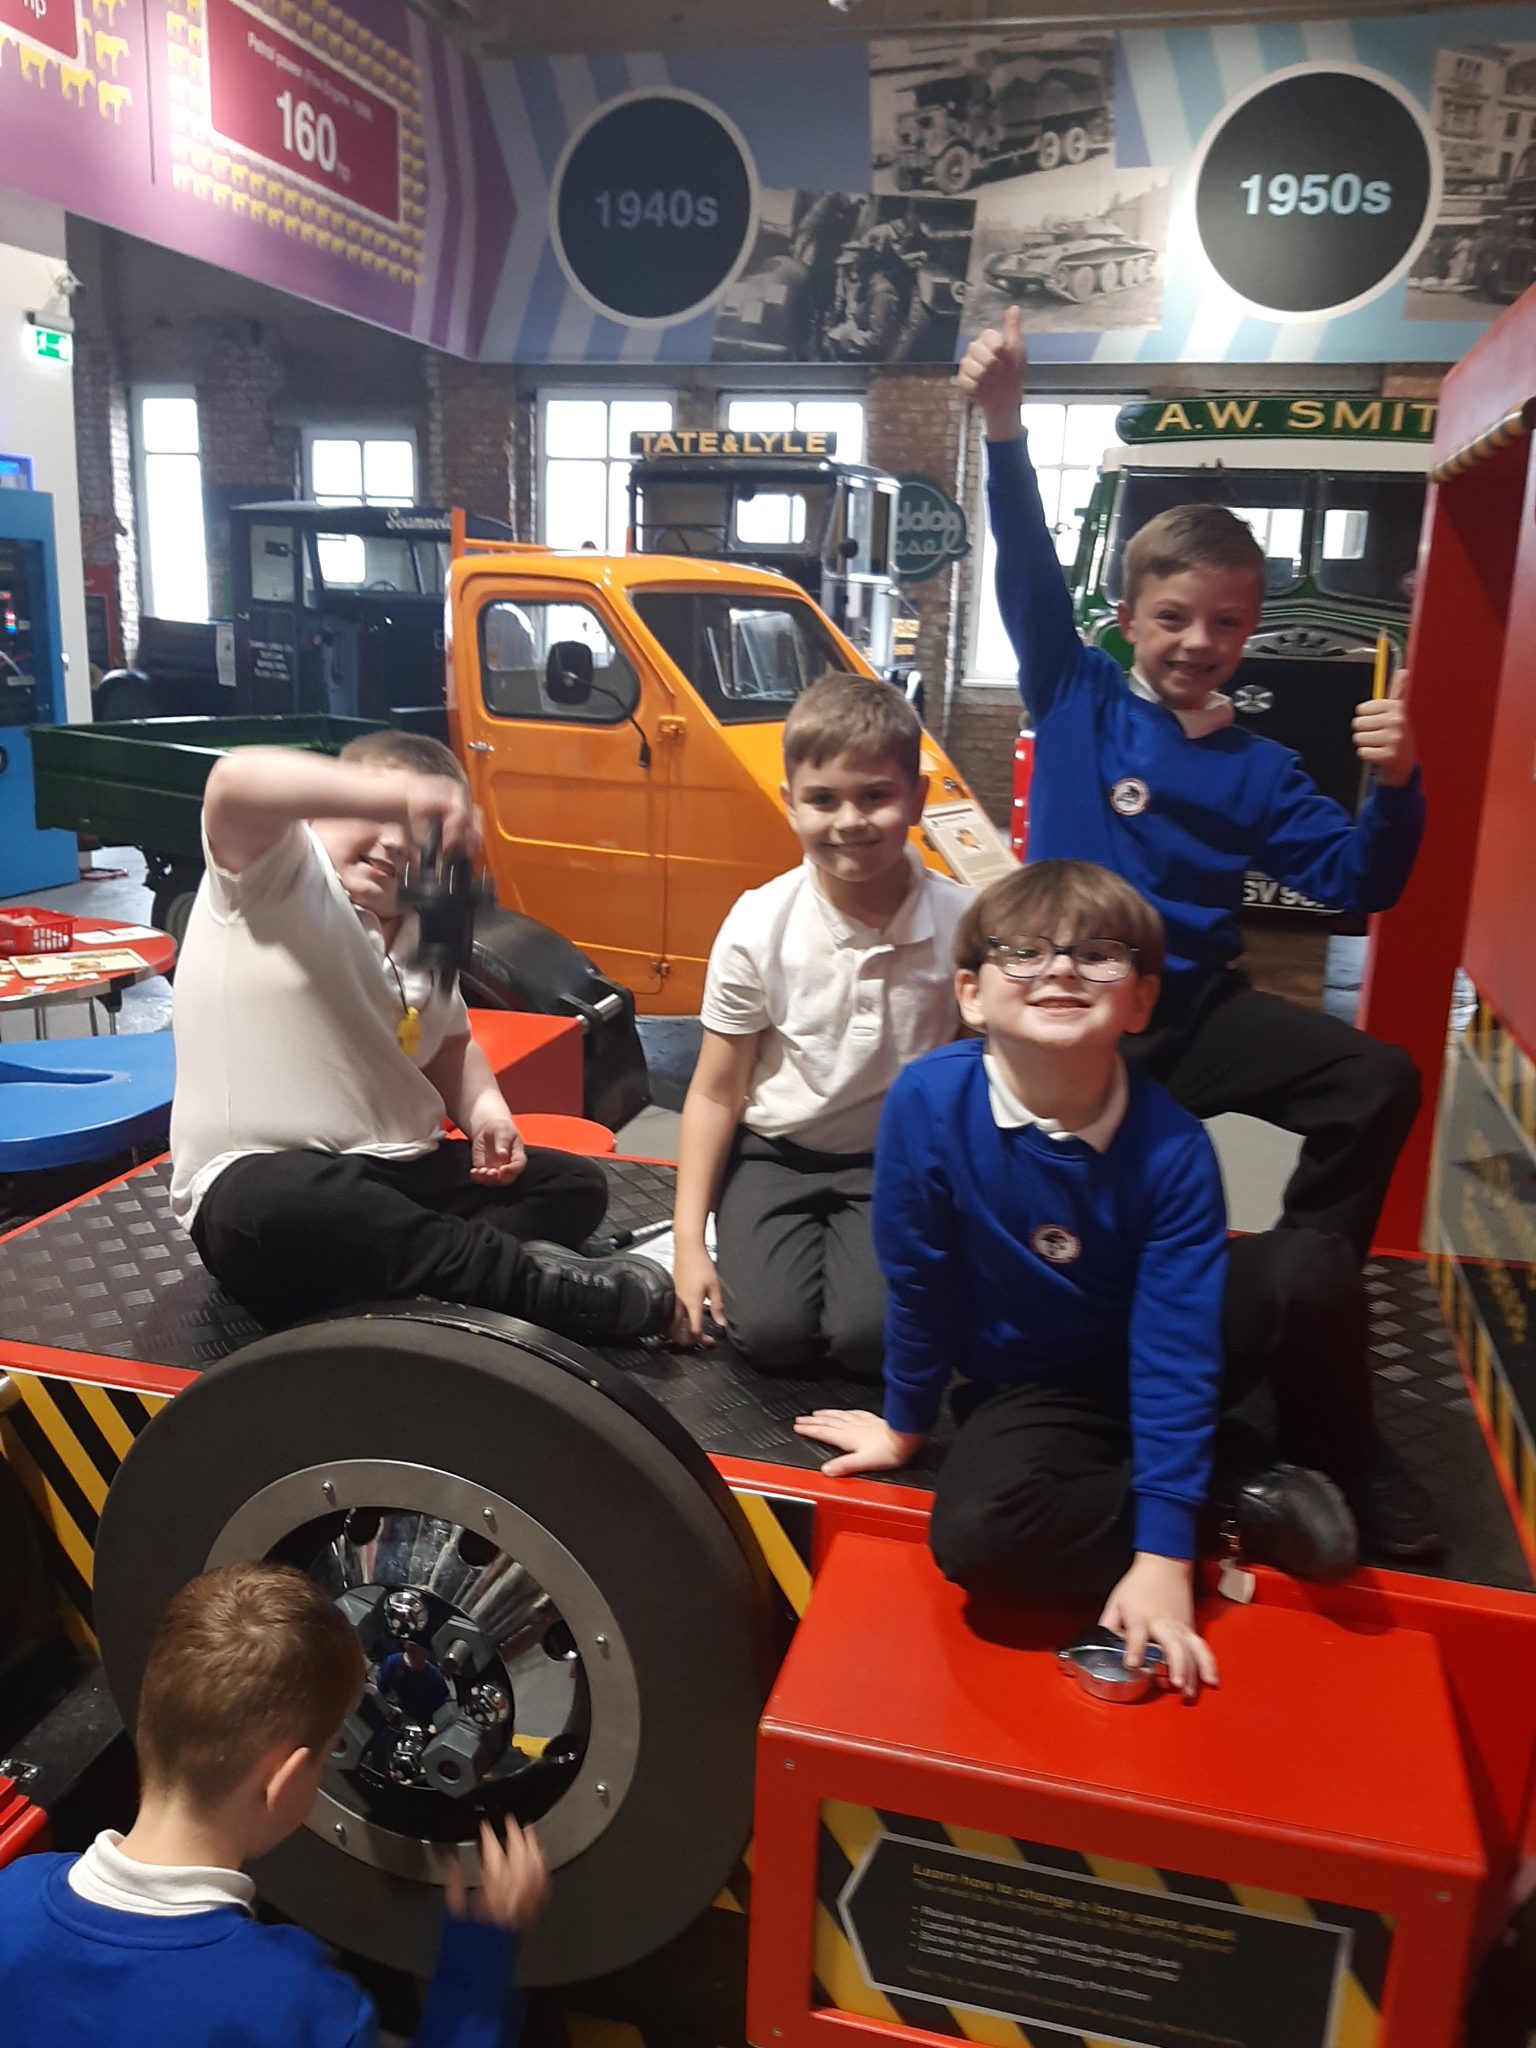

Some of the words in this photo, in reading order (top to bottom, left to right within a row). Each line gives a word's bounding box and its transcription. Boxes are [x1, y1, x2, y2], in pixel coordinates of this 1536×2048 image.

[276, 90, 337, 172] 160
[596, 189, 720, 230] 1940s
[1240, 172, 1392, 216] 1950s
[1154, 400, 1264, 431] A.W.
[636, 431, 827, 455] TATE&LYLE
